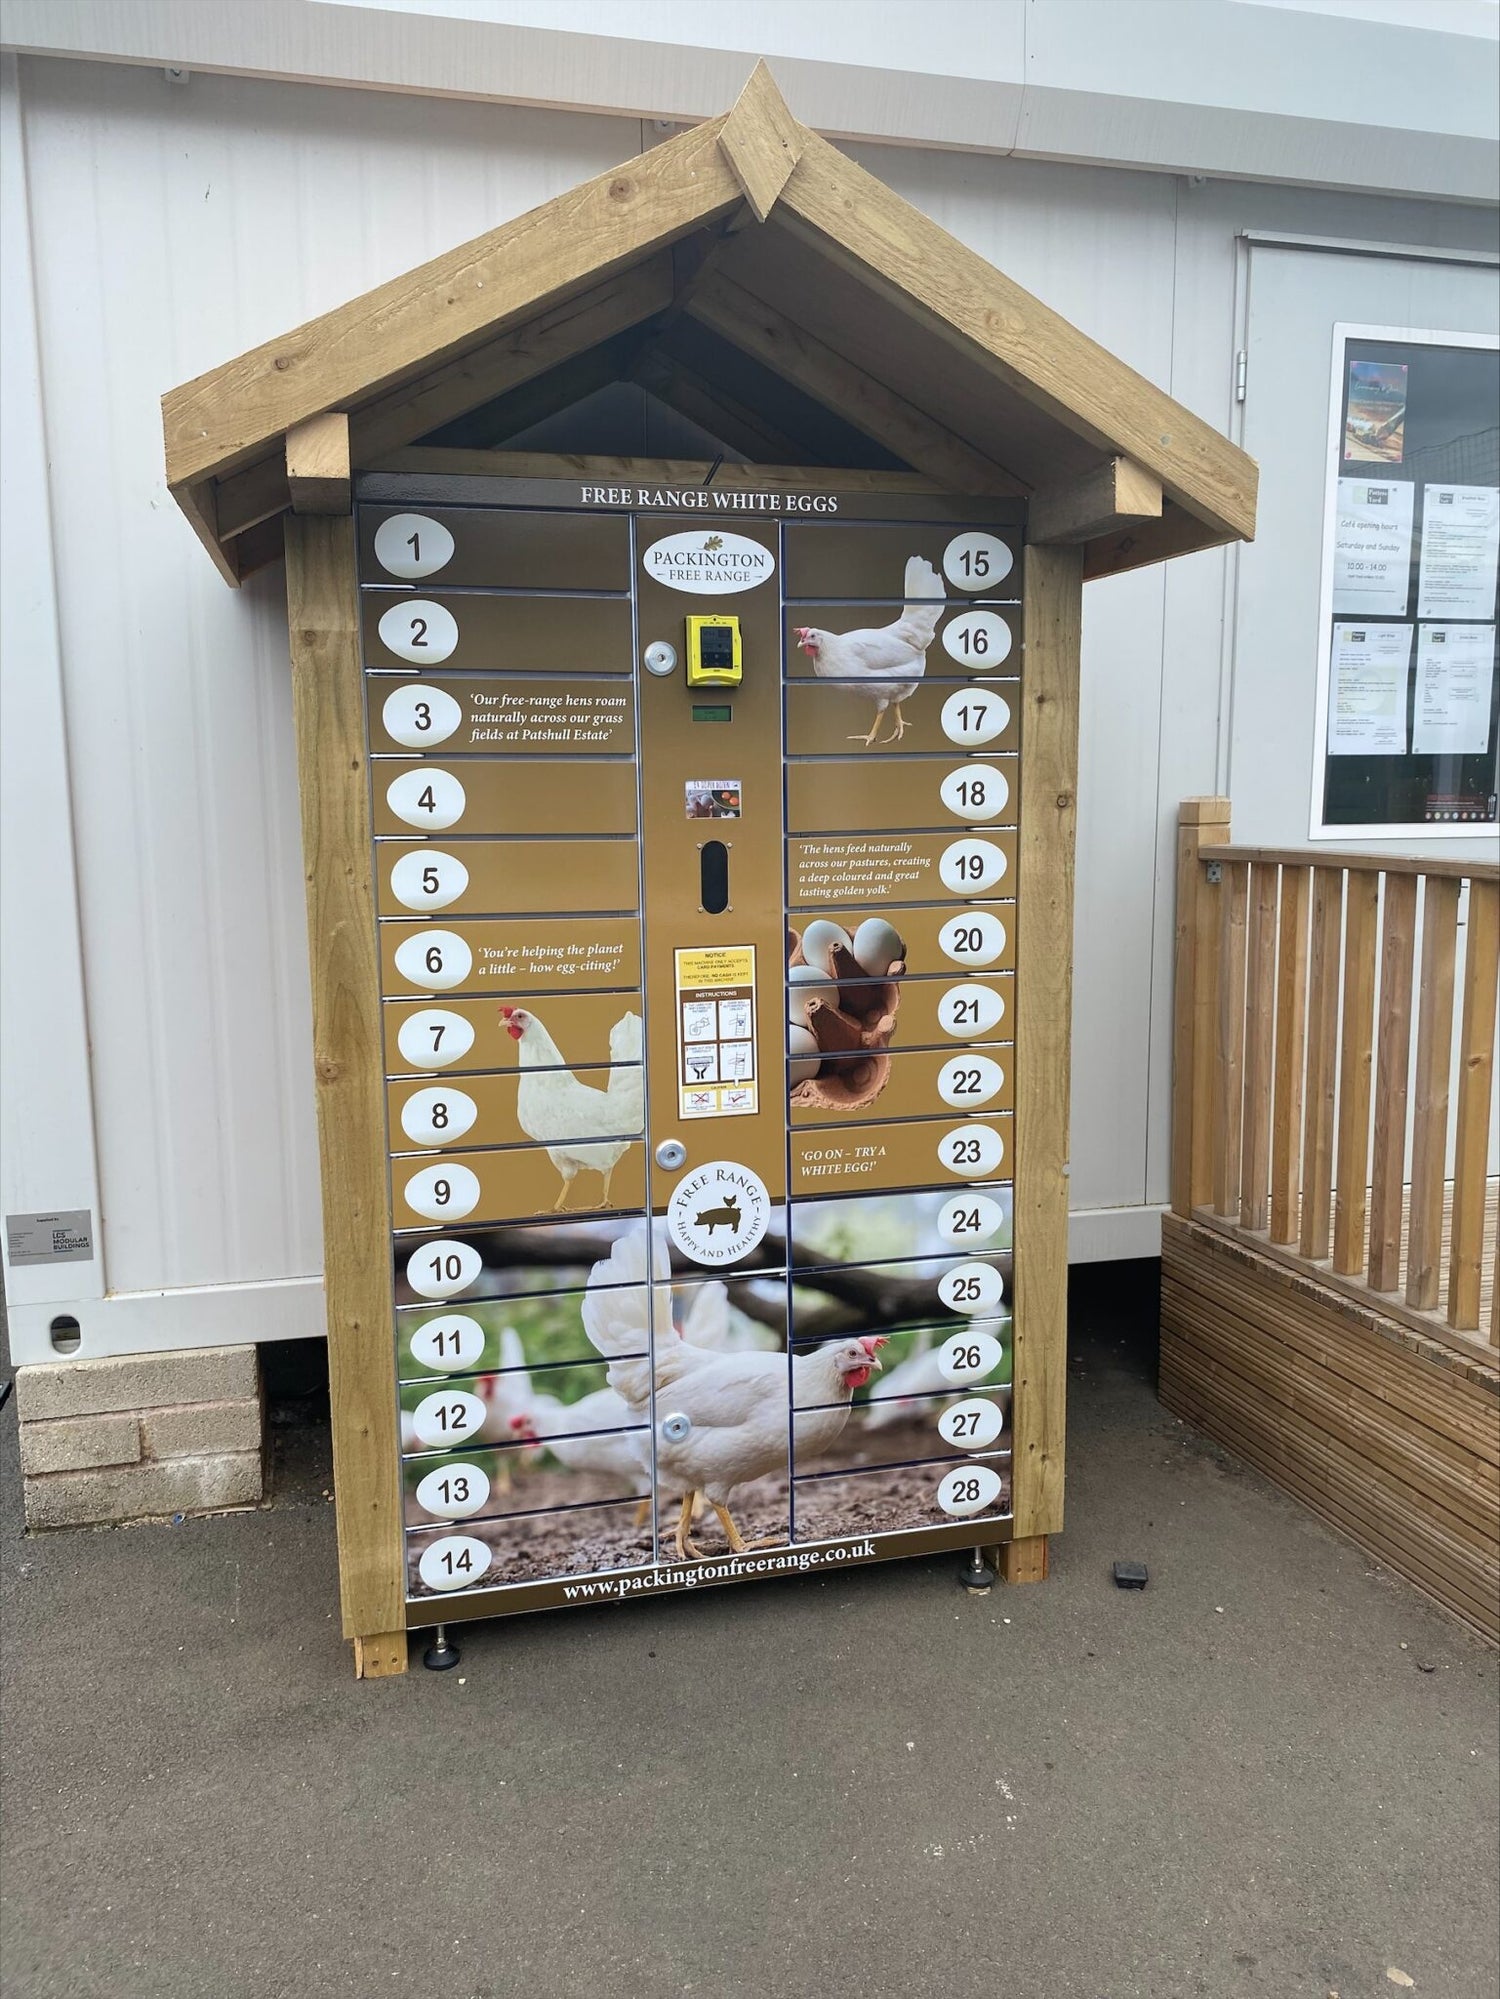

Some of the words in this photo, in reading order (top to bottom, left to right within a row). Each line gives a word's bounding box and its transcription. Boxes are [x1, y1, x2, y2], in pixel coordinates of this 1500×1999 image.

[580, 487, 632, 505] FREE
[637, 489, 709, 508] RANGE
[709, 492, 781, 511] WHITE
[785, 495, 838, 513] EGGS
[1357, 522, 1380, 531] opening
[1381, 522, 1398, 530] hours
[406, 531, 420, 562] 1
[653, 551, 765, 568] PACKINGTON
[1336, 541, 1364, 551] Saturday
[1378, 543, 1400, 552] Sunday
[669, 569, 701, 581] FREE
[705, 570, 751, 582] RANGE
[959, 549, 990, 577] 15
[410, 618, 429, 647] 2
[958, 628, 989, 655] 16
[500, 693, 562, 709] free-range
[565, 694, 592, 706] hens
[595, 698, 627, 706] roam
[414, 702, 432, 731] 3
[470, 711, 527, 726] naturally
[530, 714, 567, 723] across
[569, 714, 590, 723] our
[592, 714, 623, 727] grass
[957, 705, 988, 732] 17
[469, 728, 504, 743] fields
[506, 730, 518, 740] at
[522, 728, 571, 740] Patshull
[417, 785, 437, 813] 4
[956, 780, 986, 807] 18
[822, 844, 845, 854] hens
[845, 843, 866, 856] feed
[868, 842, 912, 853] naturally
[799, 860, 829, 869] across
[830, 860, 847, 868] our
[848, 858, 891, 869] pastures,
[893, 856, 931, 867] creating
[955, 854, 984, 881] 19
[422, 867, 440, 894] 5
[799, 875, 806, 883] a
[807, 873, 830, 884] deep
[832, 871, 873, 881] coloured
[874, 870, 893, 880] and
[894, 870, 920, 882] great
[799, 887, 831, 898] tasting
[833, 886, 864, 898] golden
[522, 945, 564, 959] helping
[567, 944, 584, 955] the
[586, 943, 624, 957] planet
[953, 927, 983, 953] 20
[425, 946, 443, 974] 6
[478, 967, 486, 975] a
[489, 963, 517, 974] little
[530, 962, 554, 973] how
[695, 990, 737, 998] INSTRUCTIONS
[952, 999, 979, 1024] 21
[429, 1025, 446, 1052] 7
[952, 1069, 982, 1095] 22
[431, 1102, 449, 1129] 8
[825, 1149, 843, 1160] ON
[855, 1146, 877, 1157] TRY
[878, 1146, 886, 1156] A
[952, 1139, 982, 1164] 23
[801, 1163, 842, 1176] WHITE
[434, 1179, 451, 1206] 9
[676, 1174, 709, 1208] FREE
[716, 1169, 762, 1205] RANGE
[952, 1208, 982, 1234] 24
[53, 1242, 90, 1250] BUILDINGS
[677, 1221, 699, 1251] HAPPY
[700, 1249, 724, 1258] AND
[727, 1216, 761, 1256] HEALTHY
[429, 1254, 462, 1282] 10
[952, 1277, 981, 1302] 25
[431, 1329, 461, 1357] 11
[952, 1345, 981, 1370] 26
[434, 1403, 467, 1431] 12
[952, 1412, 981, 1438] 27
[437, 1477, 470, 1504] 13
[952, 1478, 980, 1504] 28
[440, 1548, 473, 1575] 14
[563, 1540, 876, 1600] www.packingtonfreerange.co.uk
